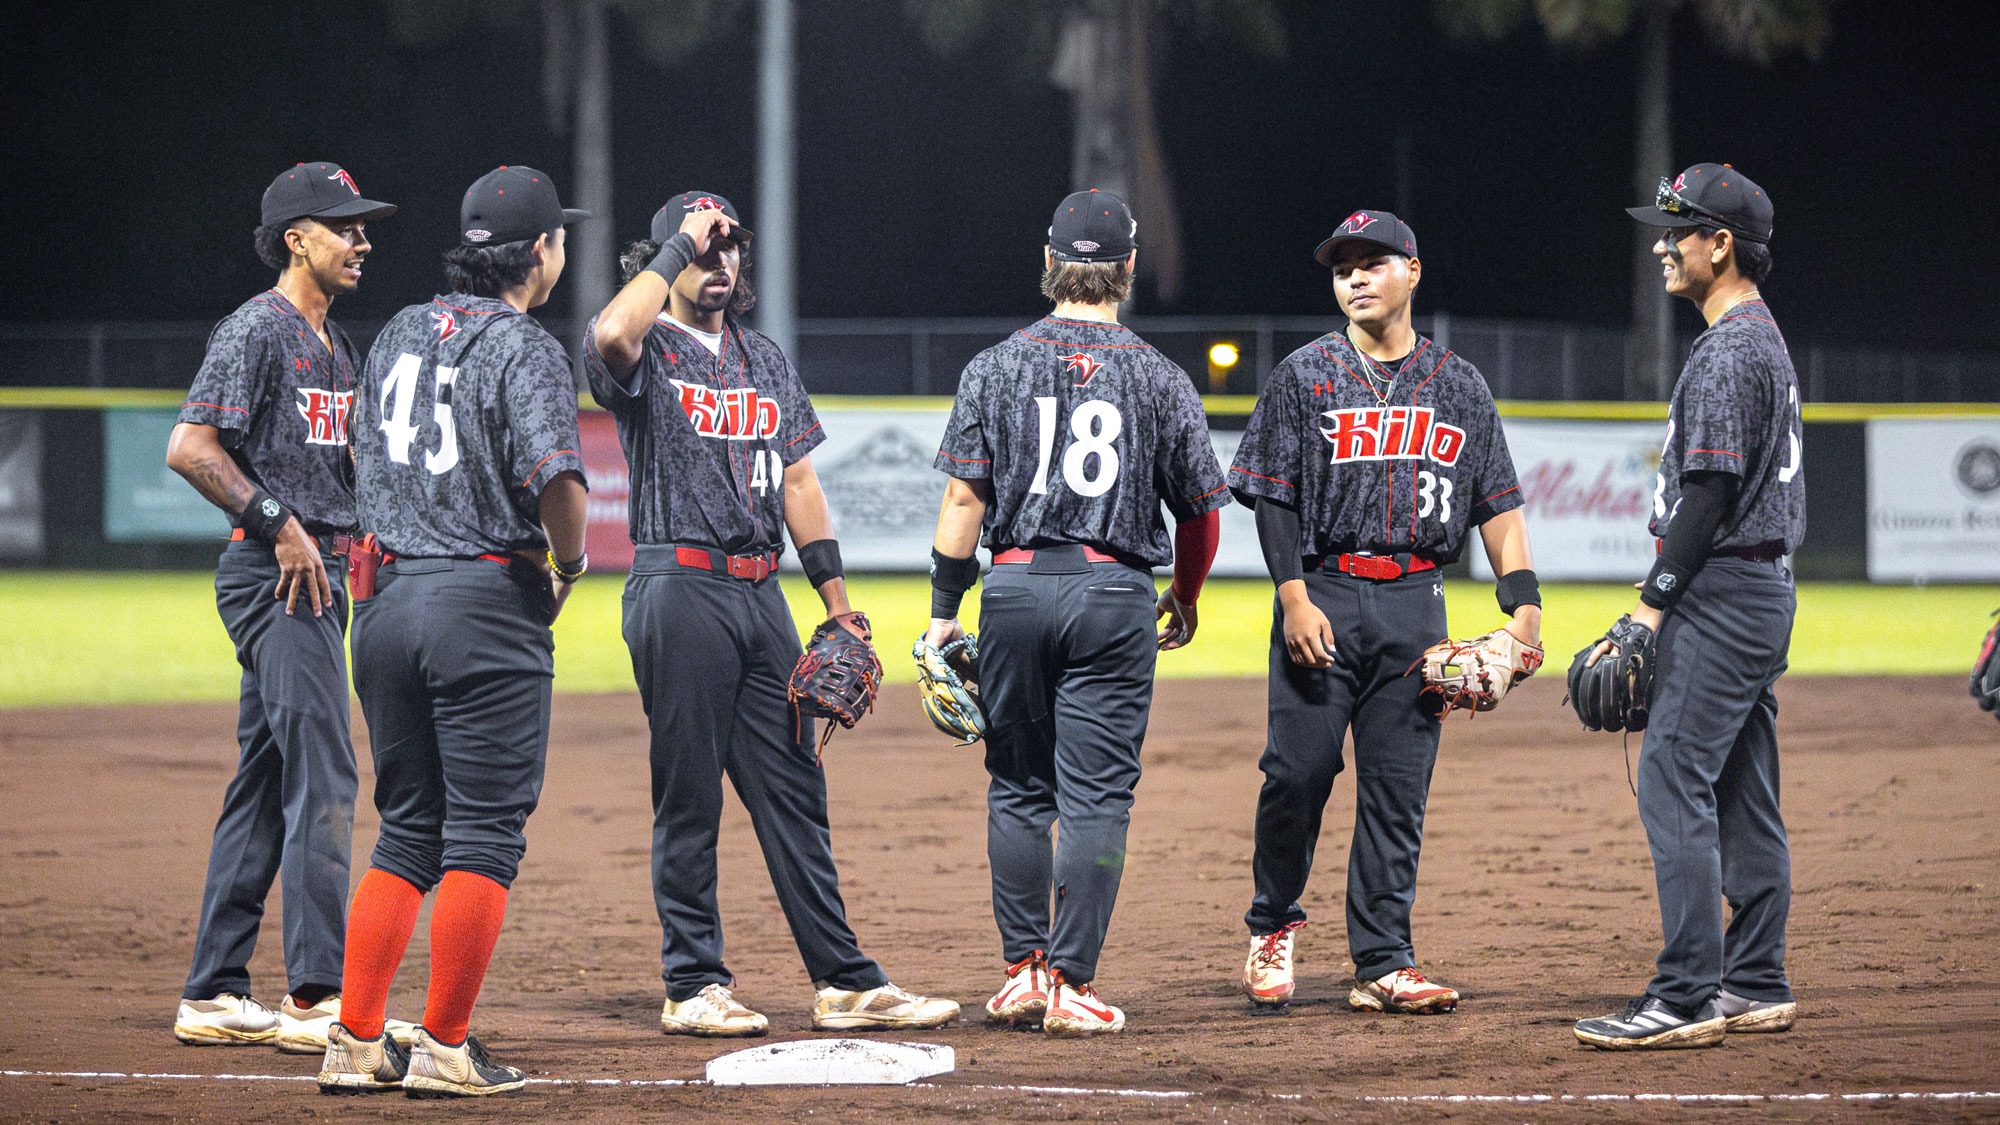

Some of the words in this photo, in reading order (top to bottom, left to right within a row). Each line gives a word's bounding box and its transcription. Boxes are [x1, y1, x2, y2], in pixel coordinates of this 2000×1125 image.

[295, 387, 354, 446] Hil
[378, 352, 460, 476] 45
[668, 378, 781, 440] Hilo
[1318, 405, 1467, 468] Hilo
[1028, 396, 1122, 498] 18
[1417, 470, 1453, 524] 33
